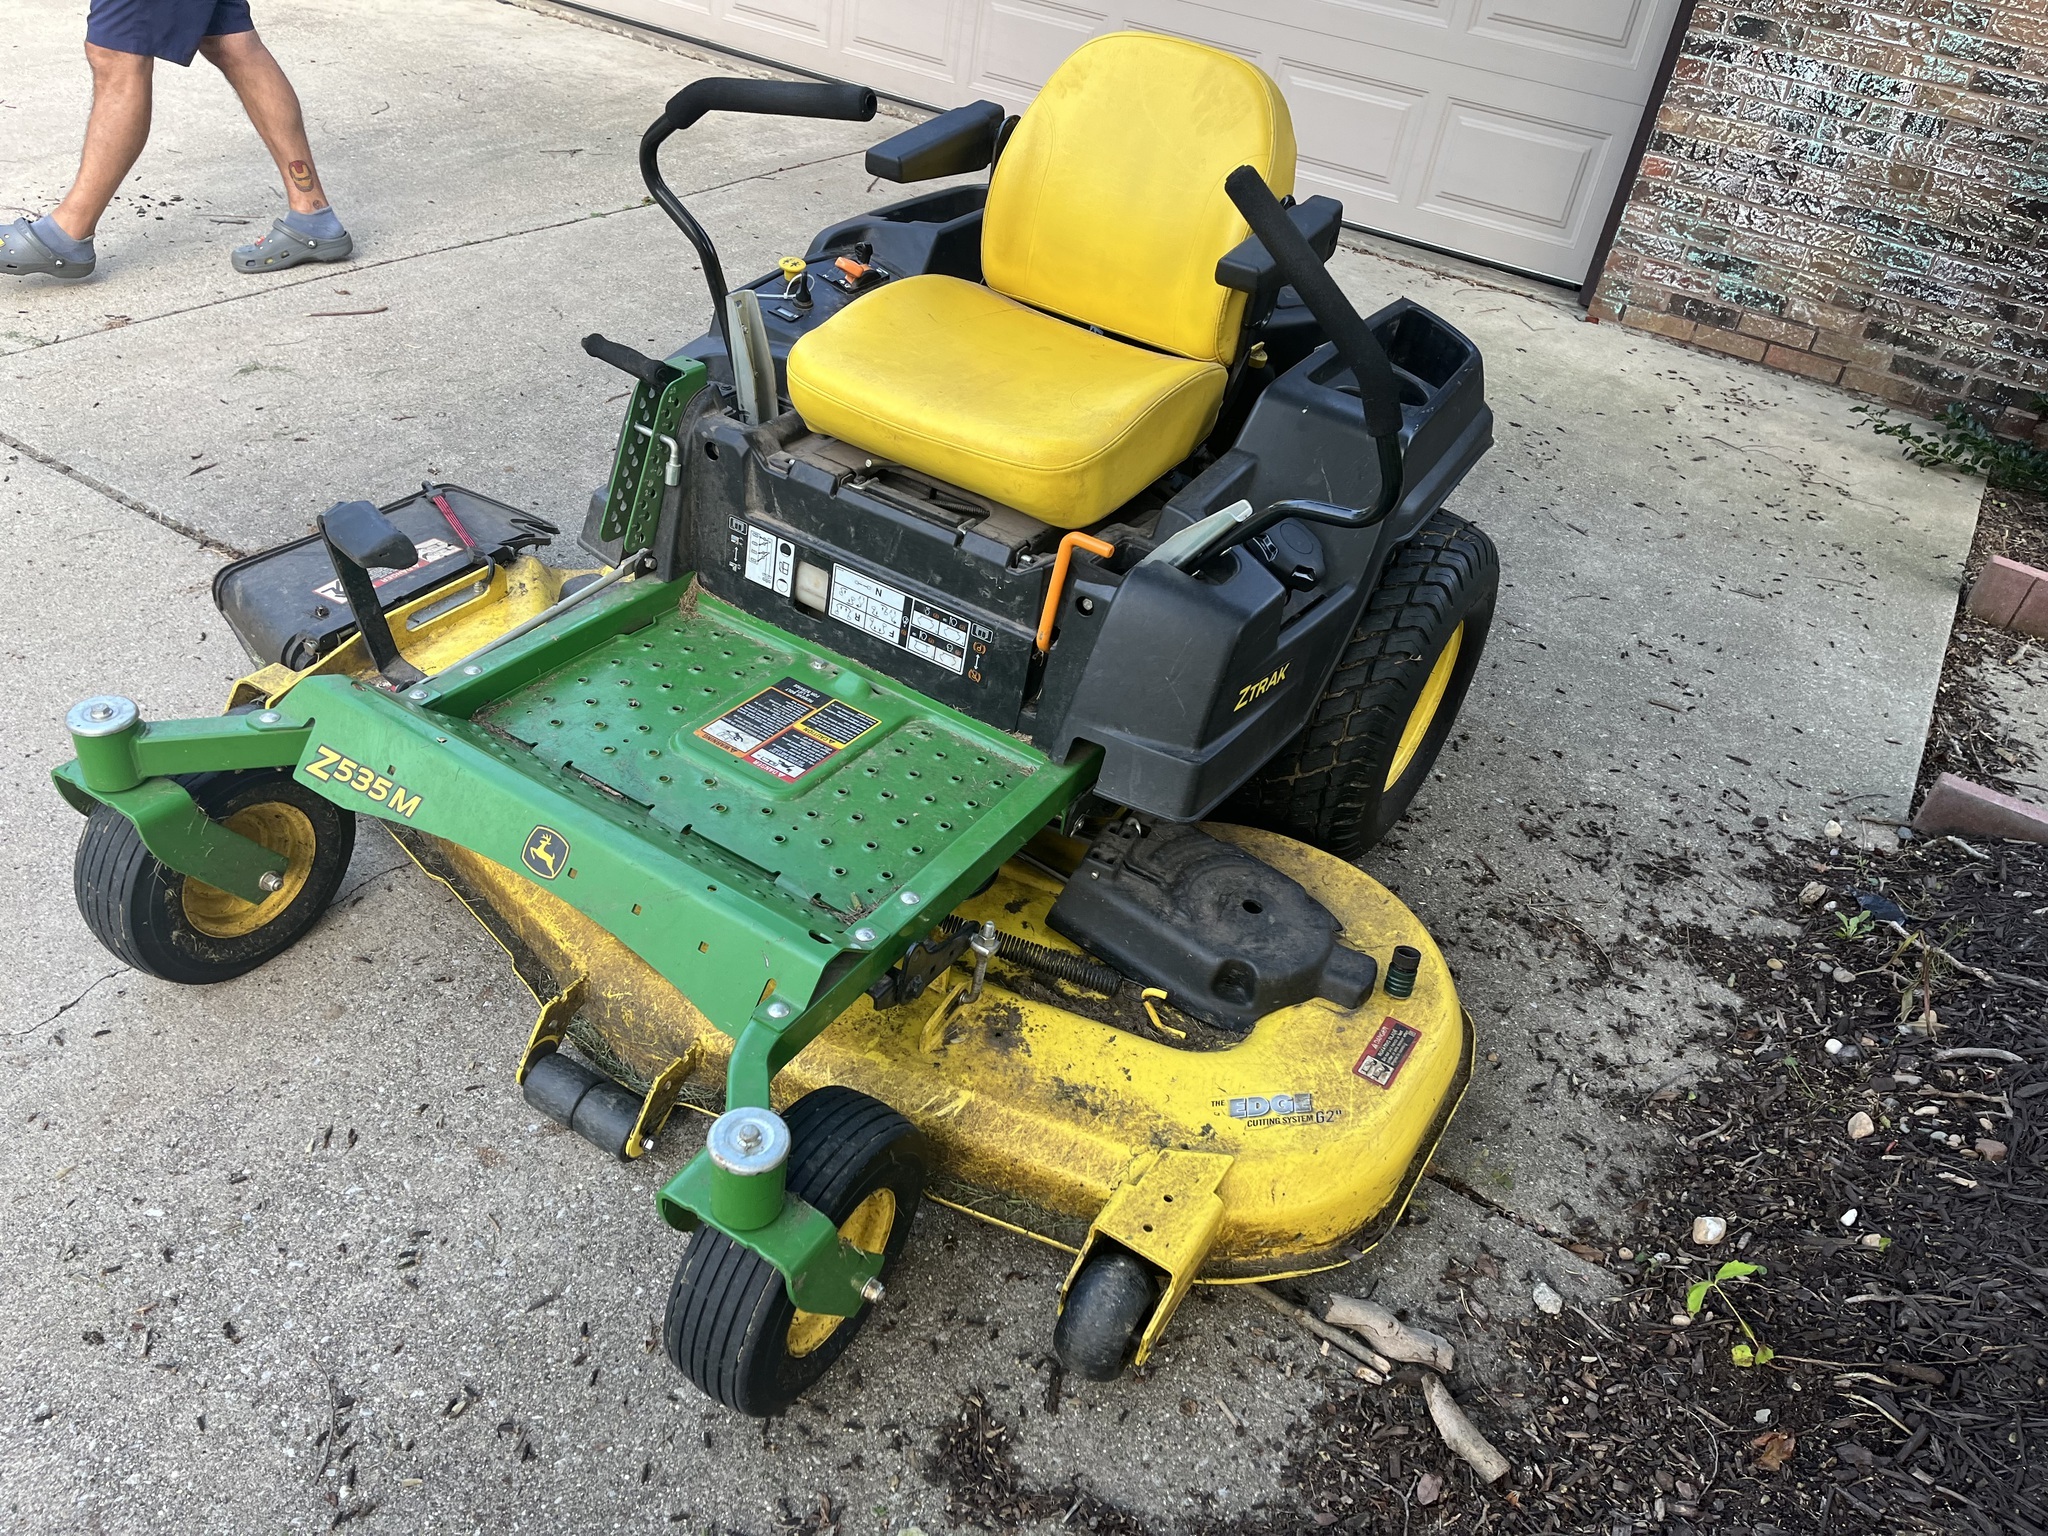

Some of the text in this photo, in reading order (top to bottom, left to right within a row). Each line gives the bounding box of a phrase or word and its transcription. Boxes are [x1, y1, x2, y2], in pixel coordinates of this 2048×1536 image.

[1233, 662, 1291, 713] ZTRAK
[703, 733, 732, 750] WARNING
[802, 726, 829, 742] CAUTION
[752, 759, 778, 774] DANGER
[303, 744, 425, 819] Z535M
[1373, 1025, 1389, 1045] DANGER
[1211, 1099, 1225, 1107] THE
[1228, 1092, 1313, 1118] EDGE
[1246, 1114, 1314, 1128] CUTTING SYSTEM
